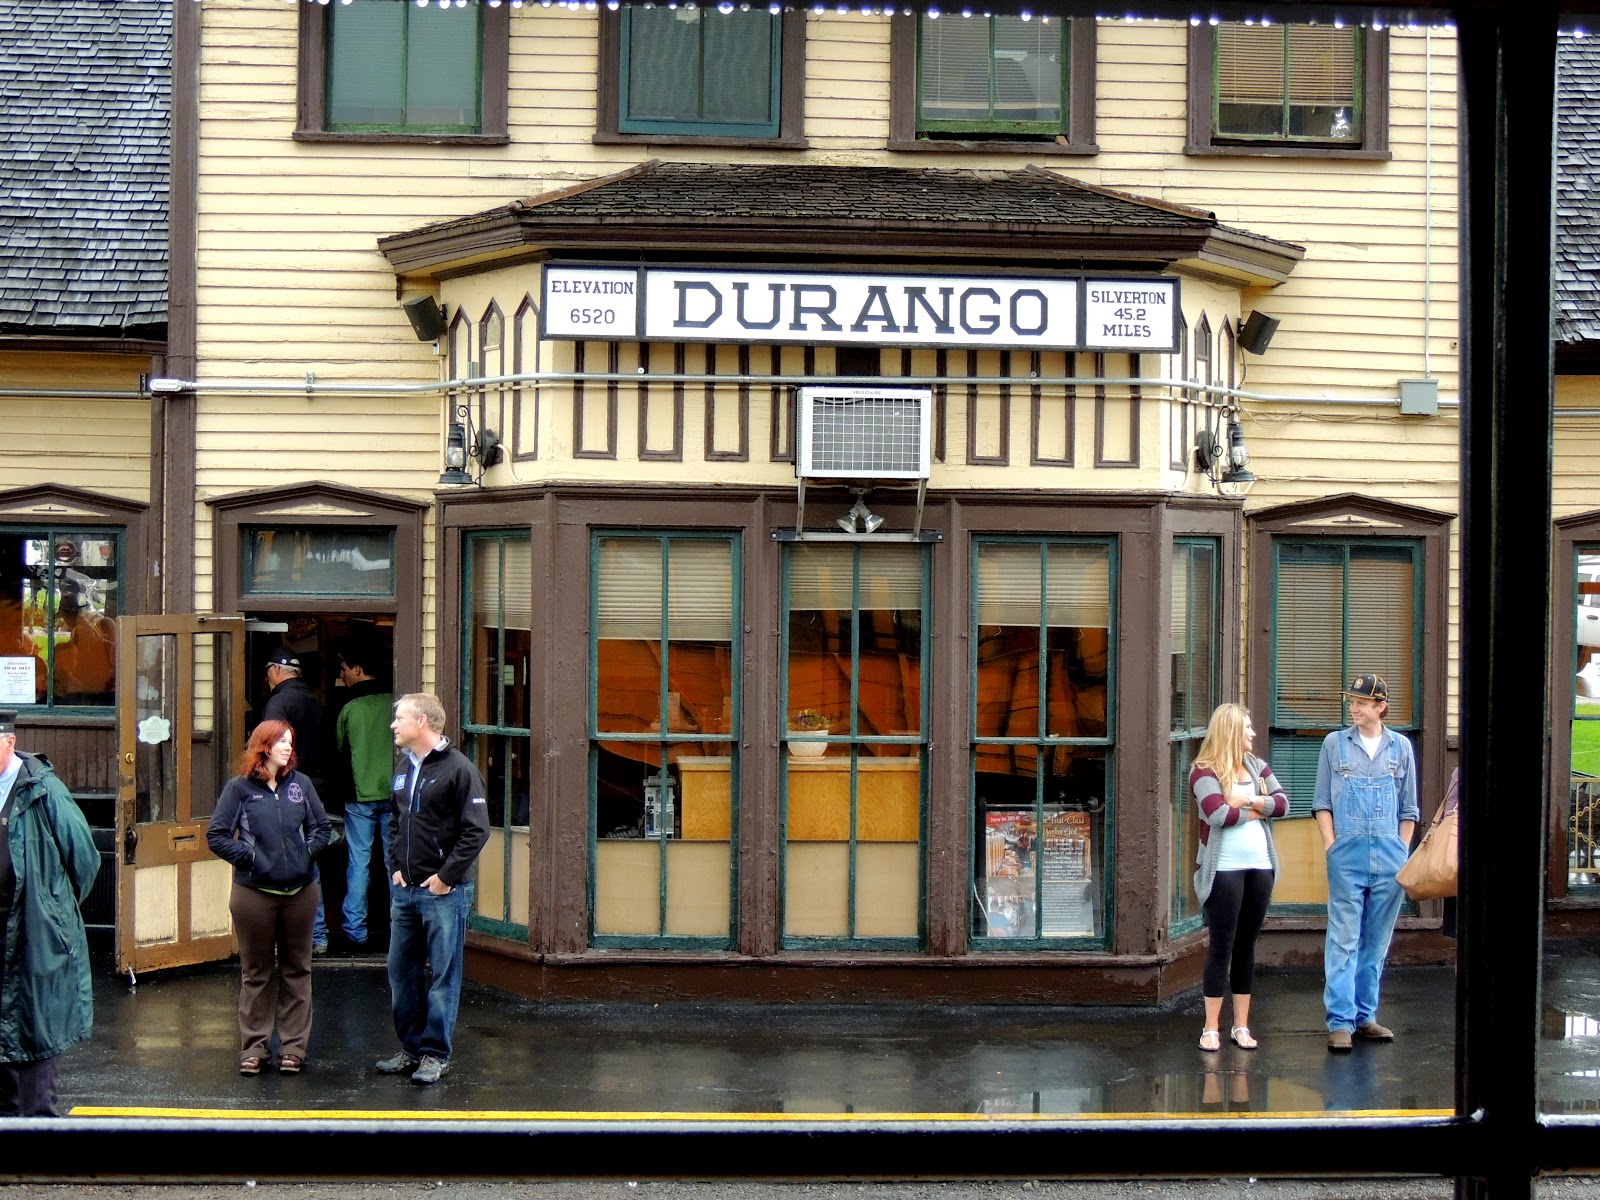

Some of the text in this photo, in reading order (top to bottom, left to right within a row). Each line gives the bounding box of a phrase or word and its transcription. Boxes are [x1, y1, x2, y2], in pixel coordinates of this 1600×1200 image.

[551, 280, 634, 295] ELEVATION
[1091, 290, 1167, 305] SILVERTON
[672, 280, 1049, 336] DURANGO
[1113, 307, 1147, 321] 45.2
[570, 308, 615, 324] 6520
[1102, 324, 1152, 338] MILES
